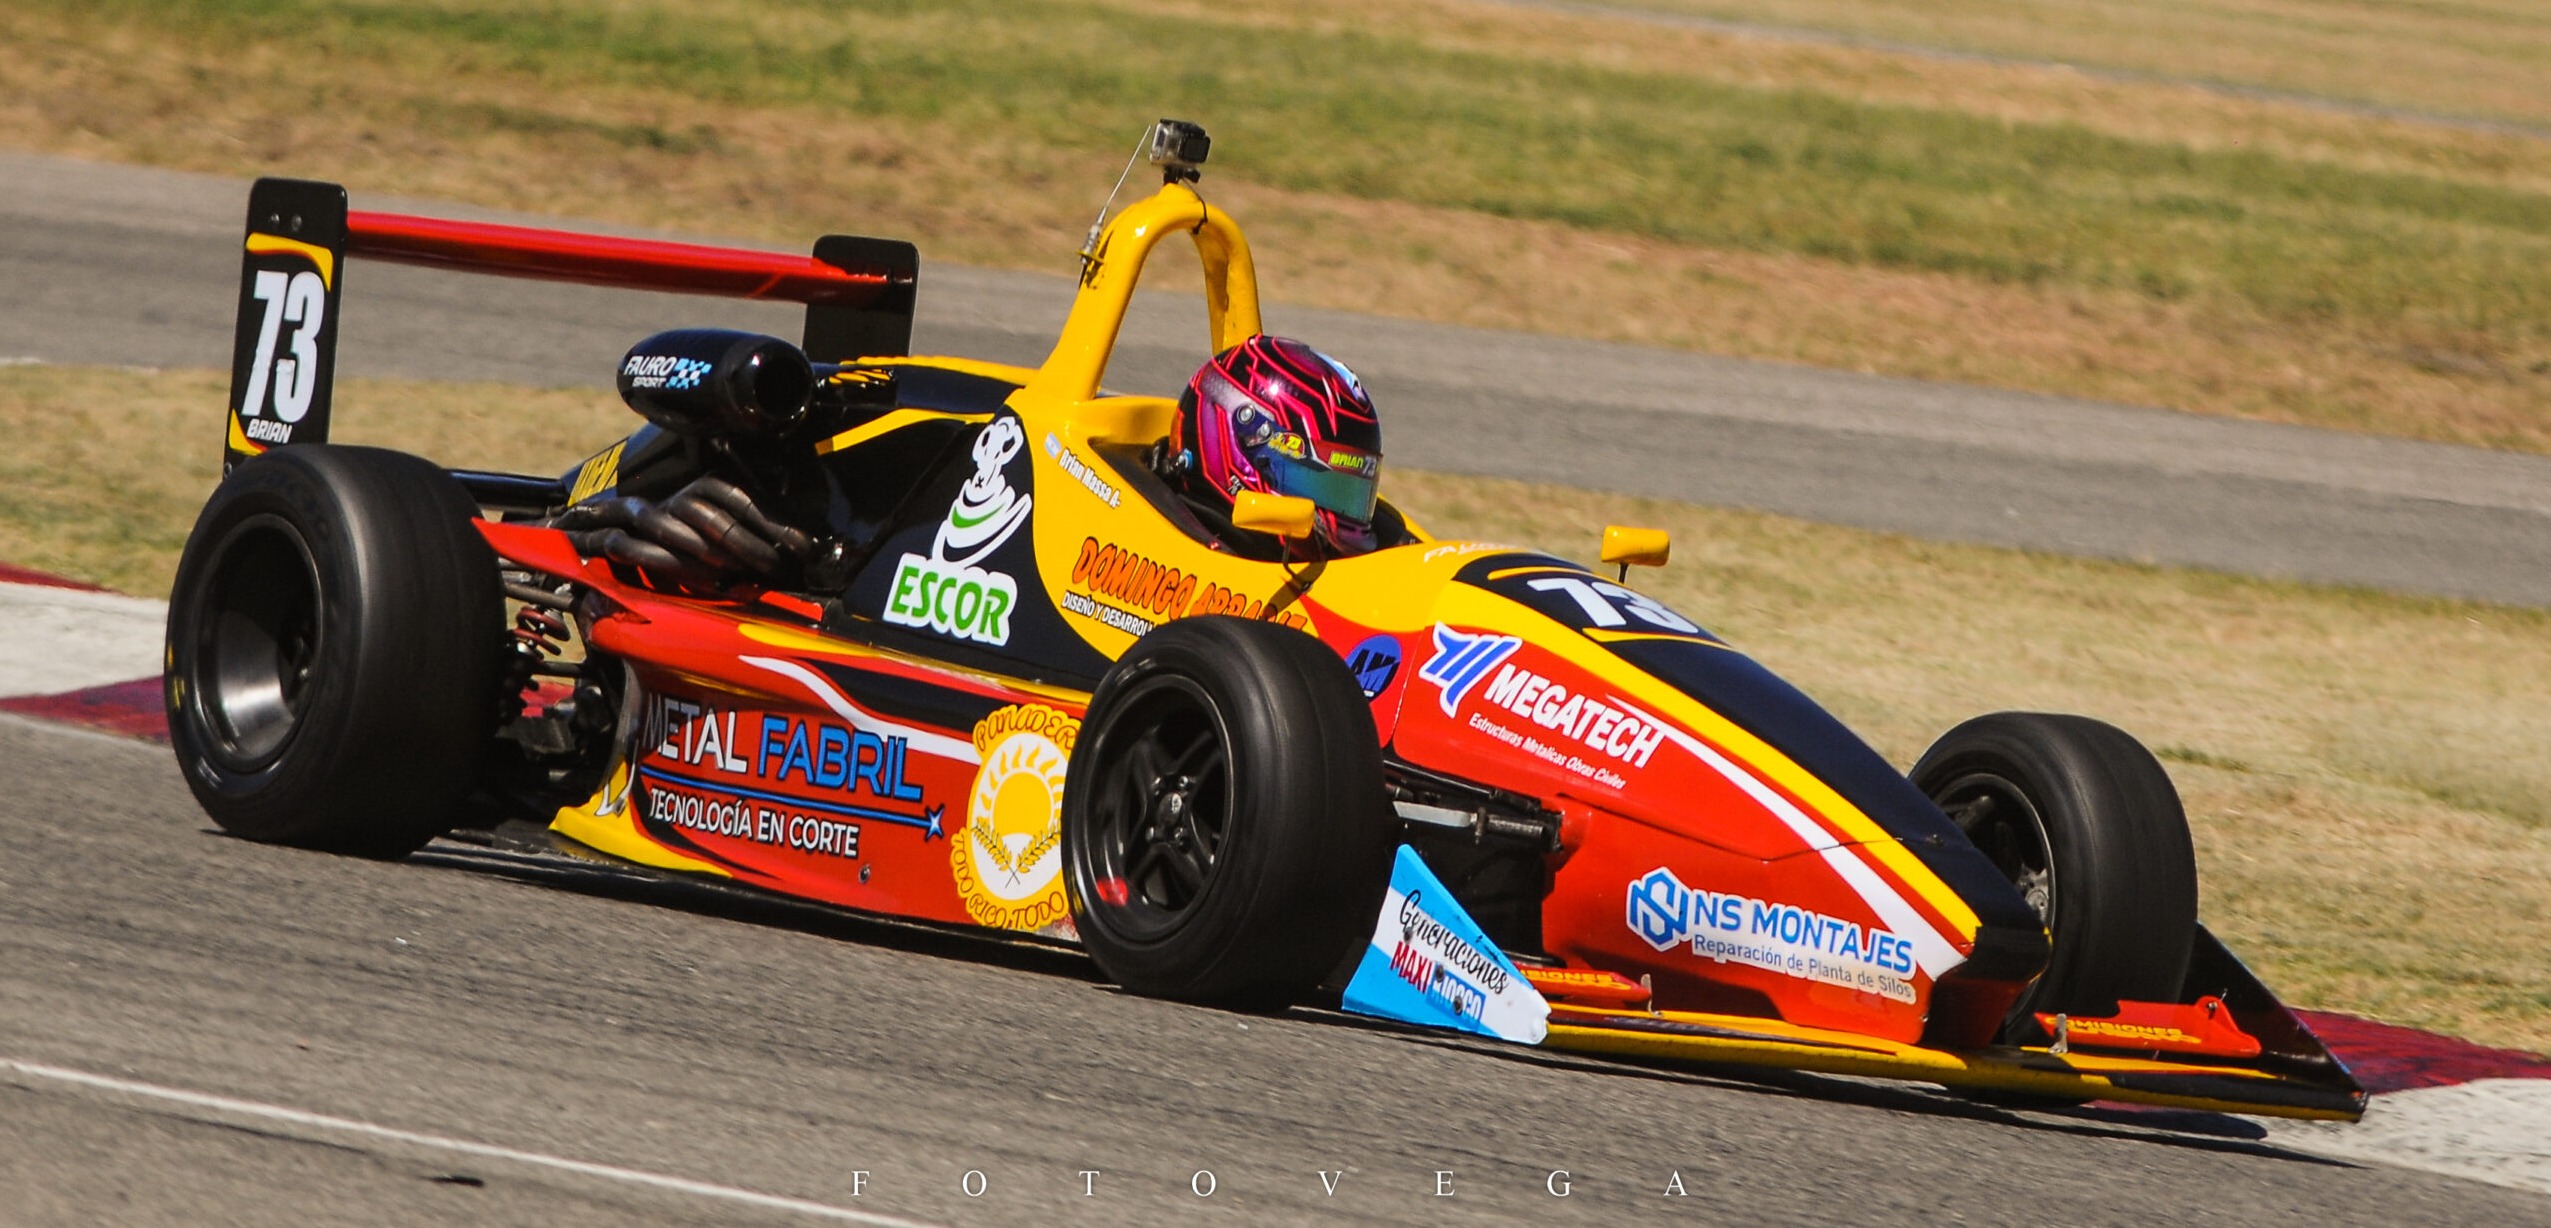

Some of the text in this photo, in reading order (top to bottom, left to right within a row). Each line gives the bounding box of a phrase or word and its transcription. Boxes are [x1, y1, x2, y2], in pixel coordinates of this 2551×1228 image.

[241, 270, 325, 422] 73
[624, 356, 677, 375] FAURO
[632, 377, 666, 388] SPORT
[247, 419, 292, 444] BRIAN
[1059, 448, 1086, 481] Brian
[1082, 467, 1113, 503] Massa
[891, 565, 1009, 639] ESCOR
[1072, 536, 1197, 620] DOMINGO
[1094, 604, 1104, 621] Y
[1527, 578, 1699, 633] 73
[641, 692, 922, 801] METAL FABRIL
[976, 707, 1078, 752] PANADER
[1484, 663, 1665, 769] MEGATECH
[1469, 712, 1524, 747] Estructuras
[1565, 756, 1596, 778] Obras
[1593, 768, 1627, 790] Civiles
[649, 788, 859, 857] TECNOLOGÍA EN CORTE
[953, 834, 974, 893] TODO
[1012, 891, 1064, 928] TODO
[1390, 940, 1433, 994] MAXI
[1399, 889, 1509, 995] Generaciones
[1694, 893, 1913, 973] NS MONTAJES
[1694, 934, 1912, 999] Reparación de Planta de Silos
